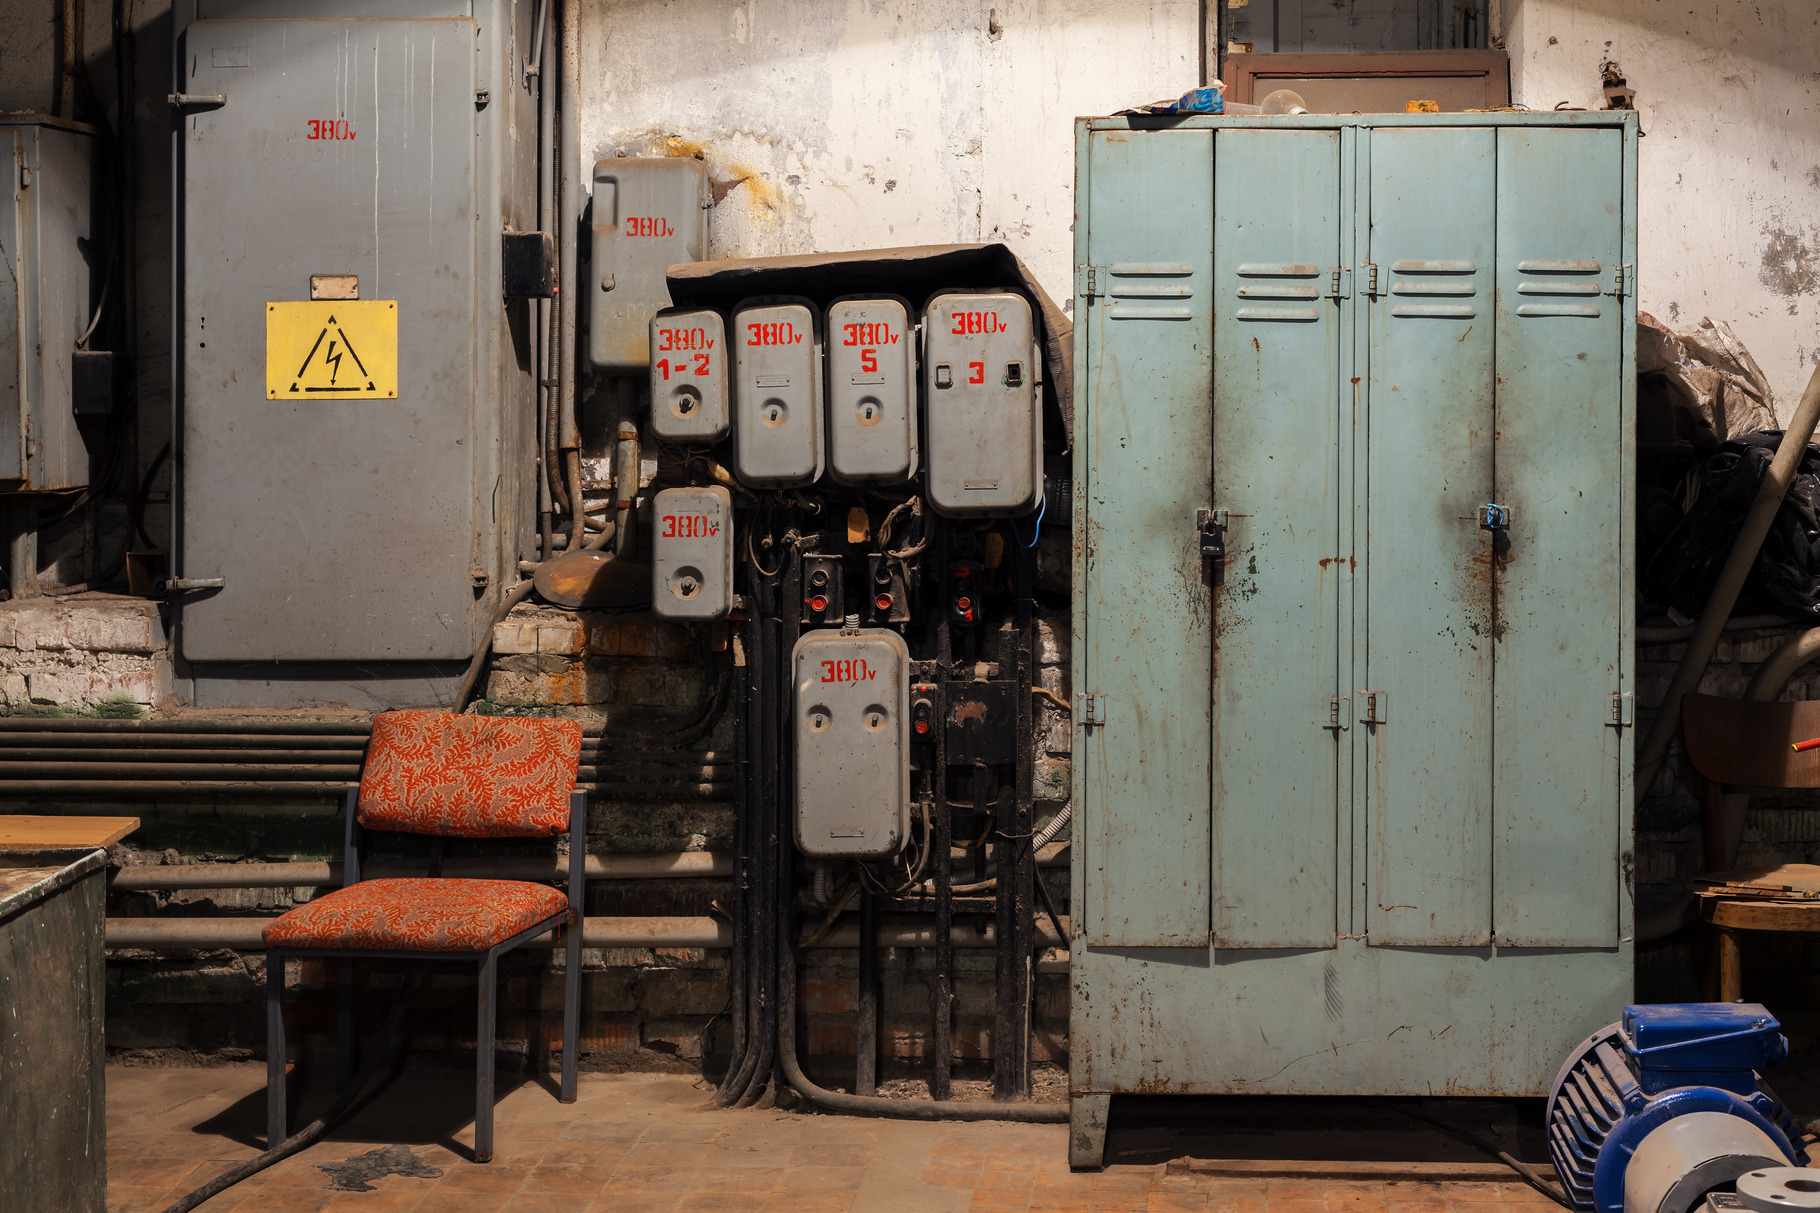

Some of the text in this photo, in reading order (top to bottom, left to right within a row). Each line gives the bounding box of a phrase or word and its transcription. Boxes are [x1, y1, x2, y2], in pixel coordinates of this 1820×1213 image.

[307, 120, 357, 140] 380v
[626, 217, 675, 237] 380v
[747, 323, 803, 346] 380v
[842, 323, 899, 346] 380v
[952, 312, 1008, 335] 380v
[659, 328, 714, 351] 380v
[861, 348, 878, 373] 5
[968, 361, 985, 384] 3
[662, 515, 717, 538] 380v
[821, 658, 877, 683] 380v
